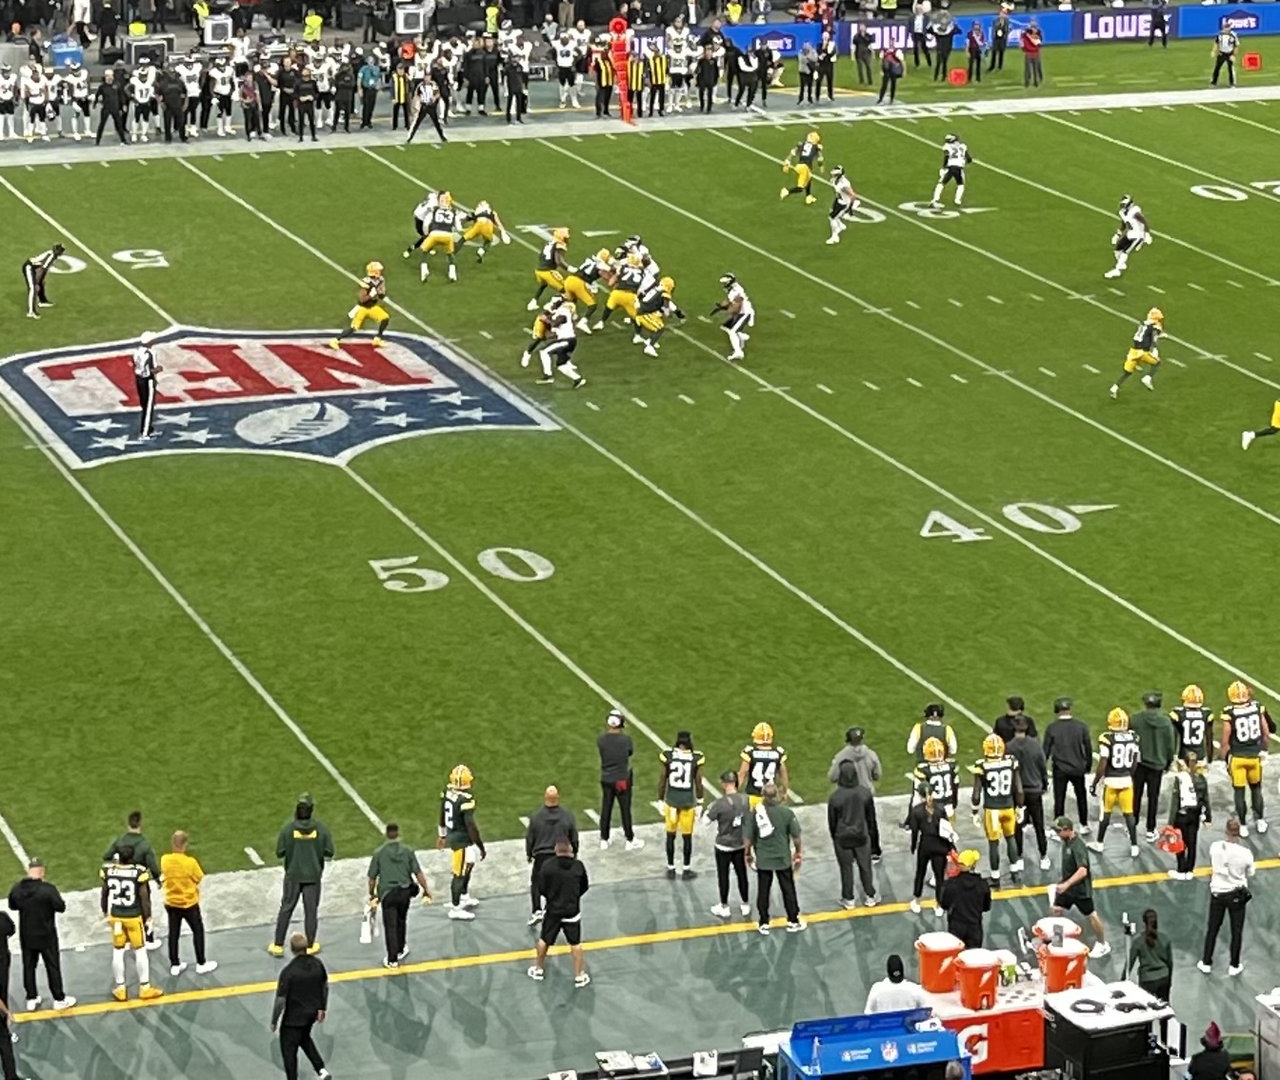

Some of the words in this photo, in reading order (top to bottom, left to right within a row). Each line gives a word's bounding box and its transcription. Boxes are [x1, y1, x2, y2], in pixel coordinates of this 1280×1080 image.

[433, 209, 455, 224] 63
[1182, 719, 1206, 745] 13
[1235, 713, 1262, 743] 88
[1111, 743, 1137, 770] 80
[669, 761, 692, 789] 21
[750, 761, 778, 788] 44
[929, 773, 954, 800] 31
[986, 768, 1013, 797] 38
[106, 878, 137, 907] 23
